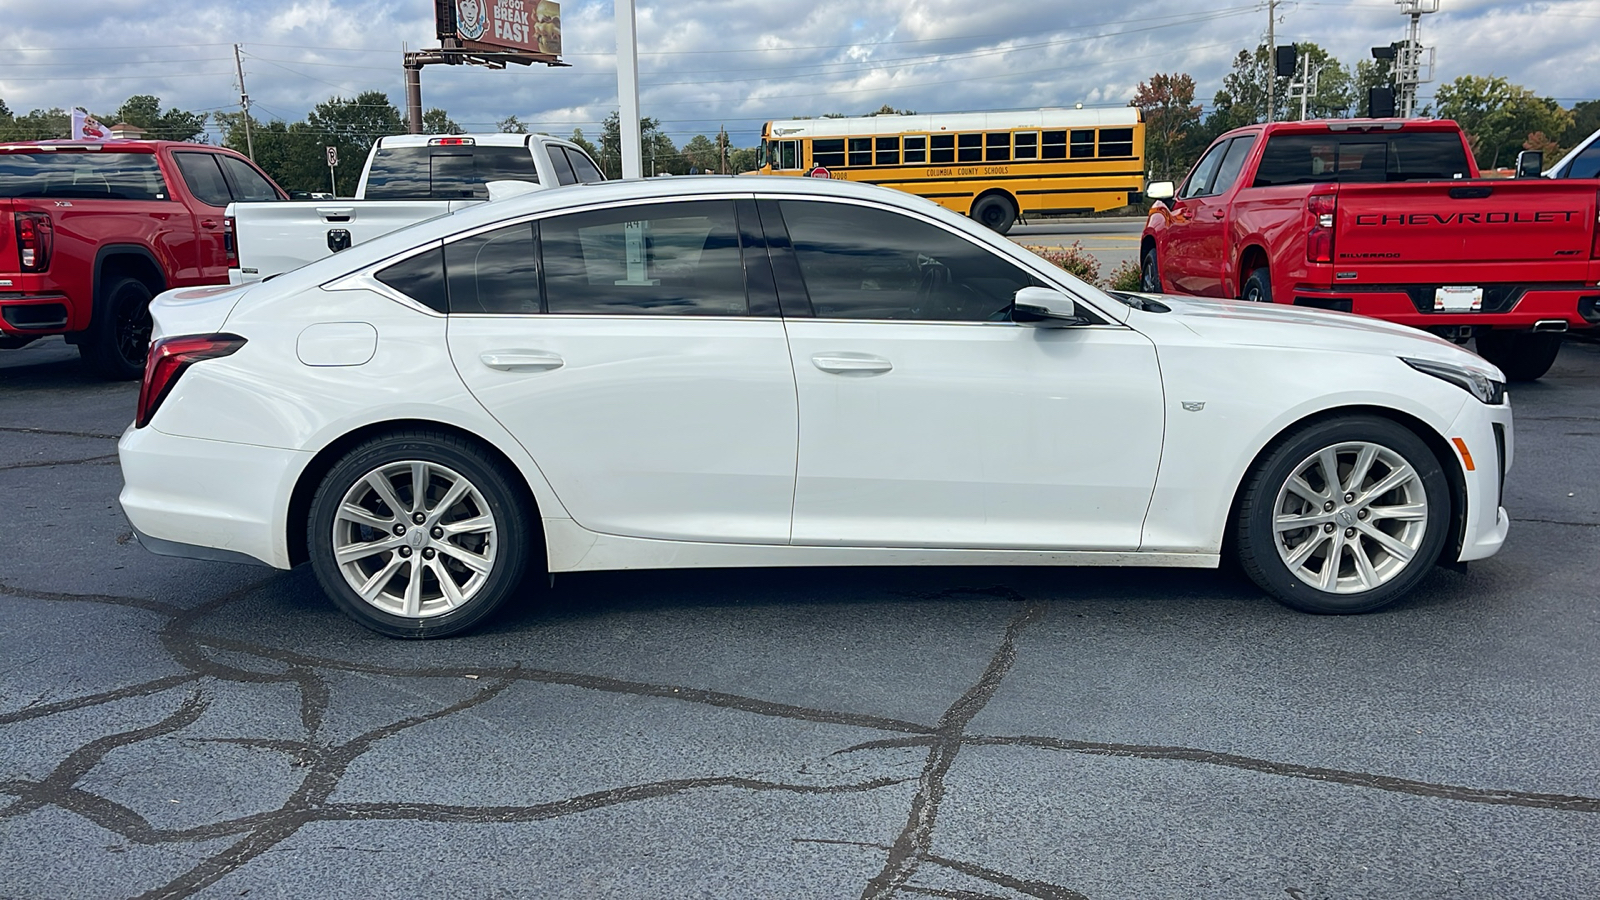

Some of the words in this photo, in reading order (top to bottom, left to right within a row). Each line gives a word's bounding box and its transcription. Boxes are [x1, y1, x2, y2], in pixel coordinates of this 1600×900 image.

[493, 5, 529, 25] BREAK
[494, 19, 529, 44] FAST
[926, 168, 953, 177] COLUMBIA
[957, 167, 979, 176] COUNTY
[984, 166, 1009, 175] SCHOOLS
[1356, 211, 1580, 226] CHEVROLET
